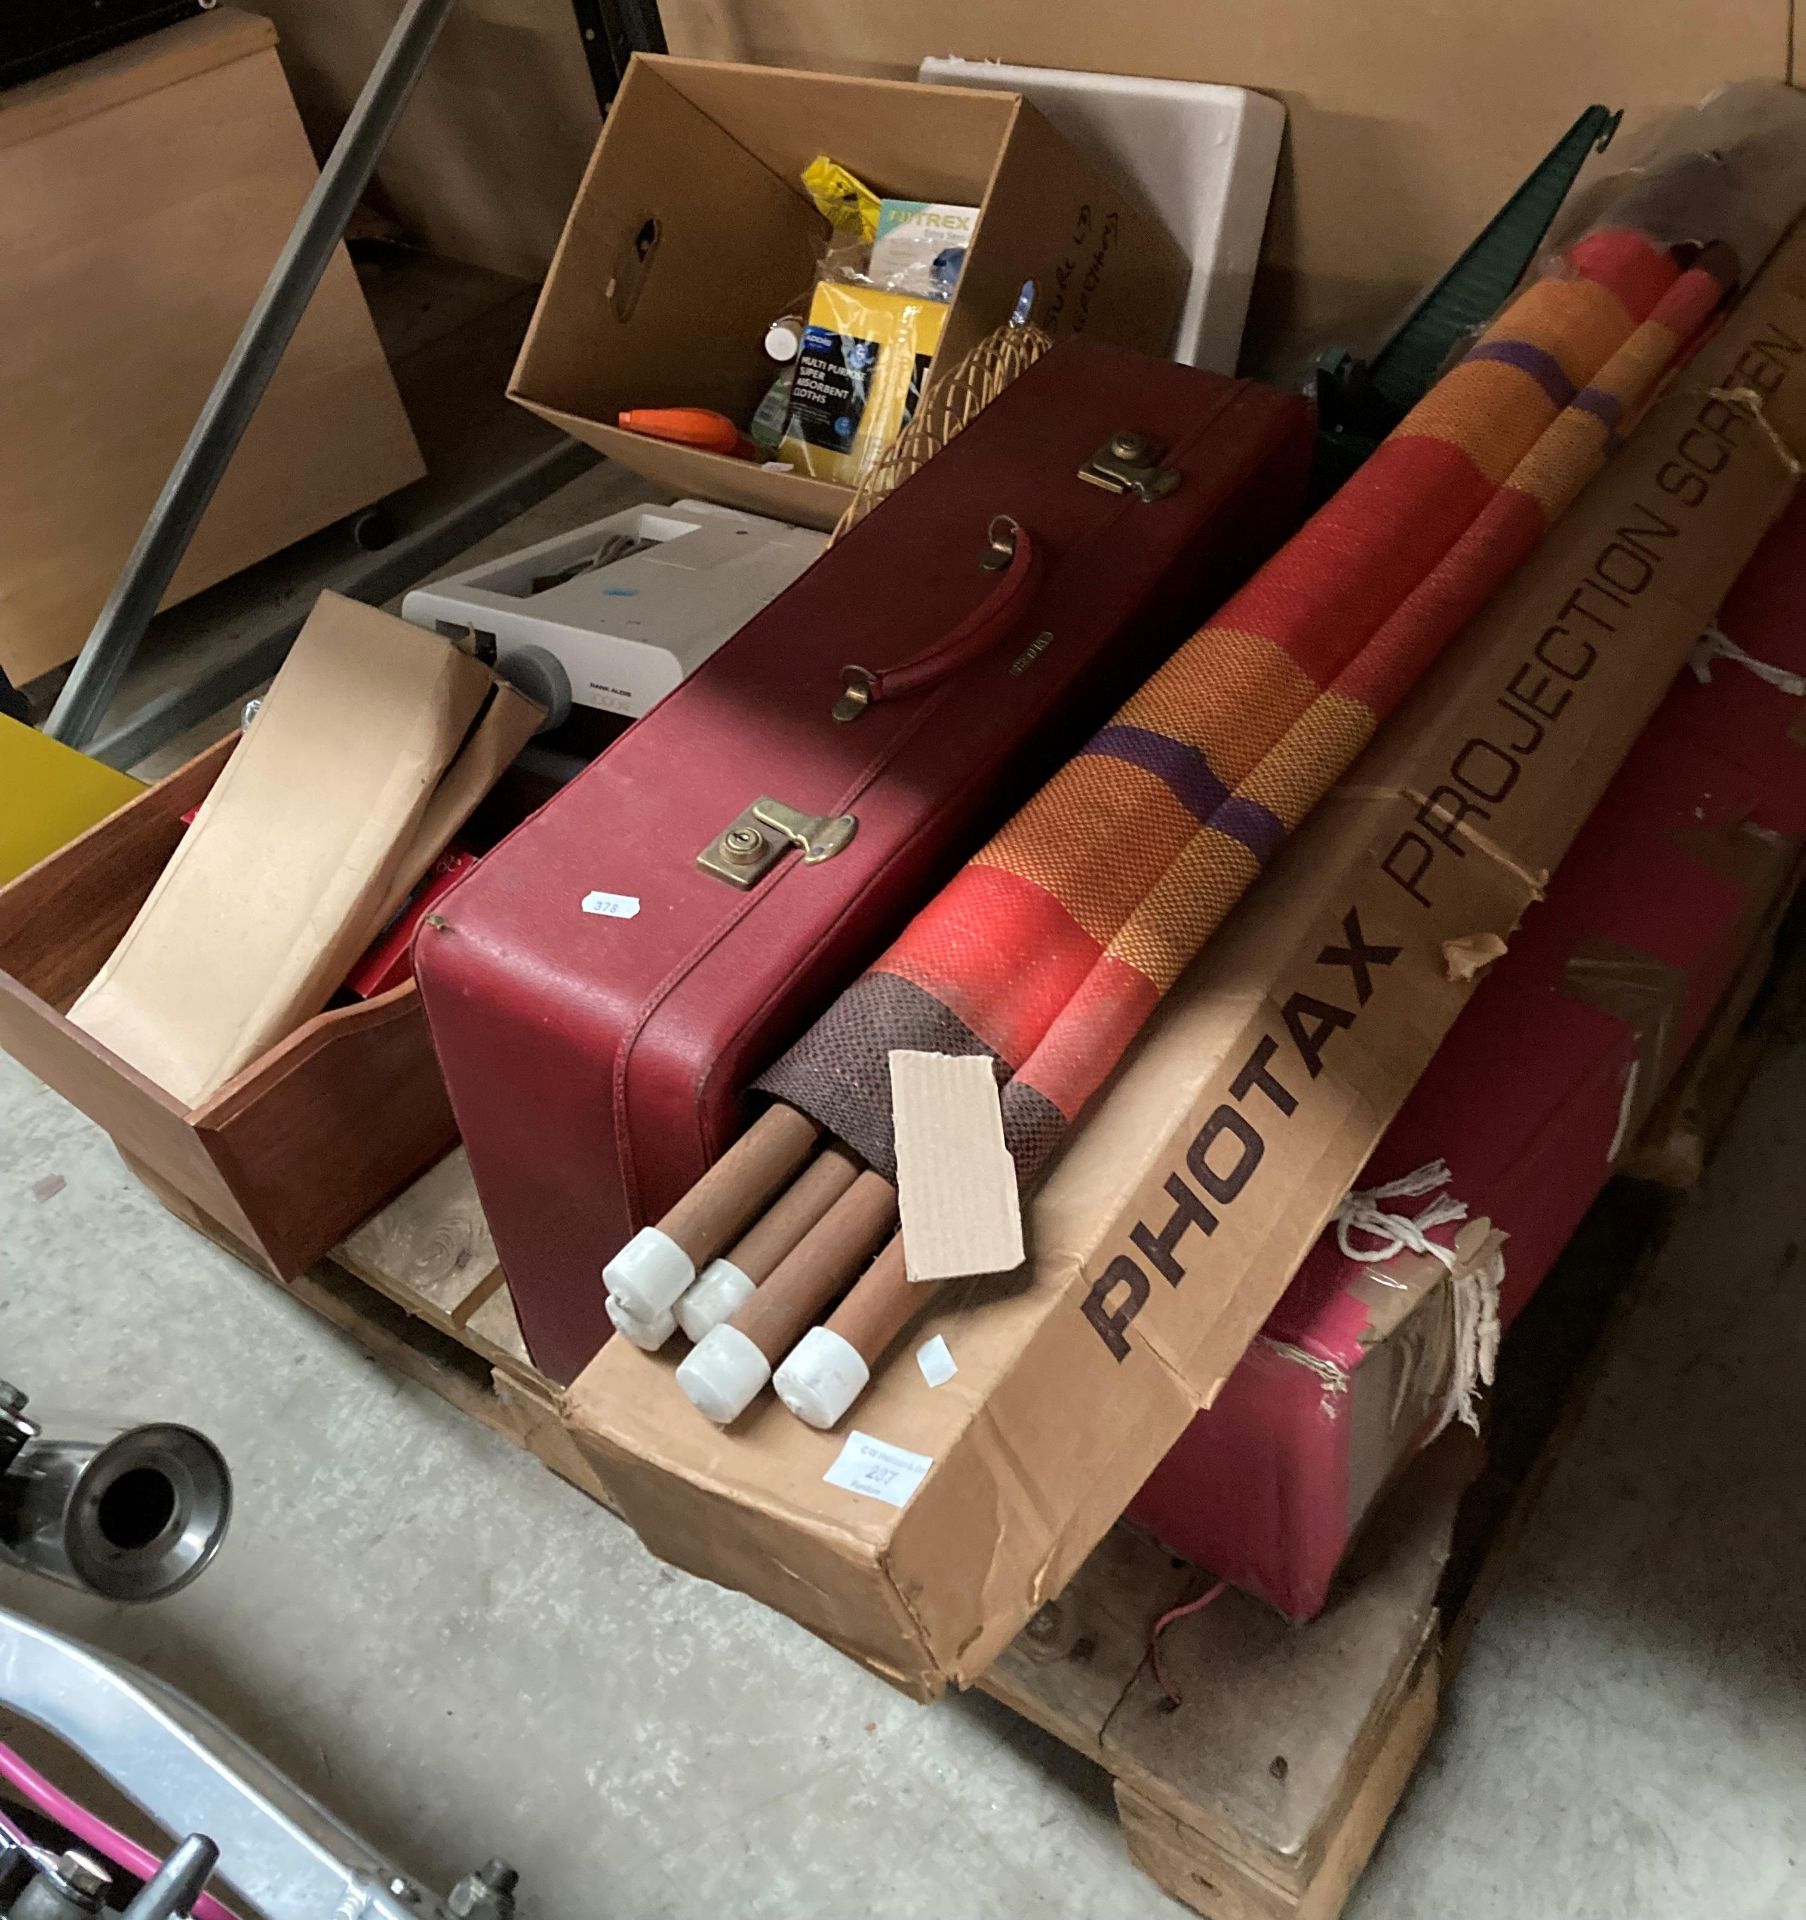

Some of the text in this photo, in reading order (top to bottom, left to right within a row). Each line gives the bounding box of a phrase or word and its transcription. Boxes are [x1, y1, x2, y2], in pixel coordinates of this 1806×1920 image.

[801, 356, 827, 370] MULTI
[799, 366, 826, 381] SUPER
[796, 378, 849, 400] ABSORBENT
[1080, 905, 1403, 1364] PHOTAX
[1381, 503, 1680, 909] PROJECTION
